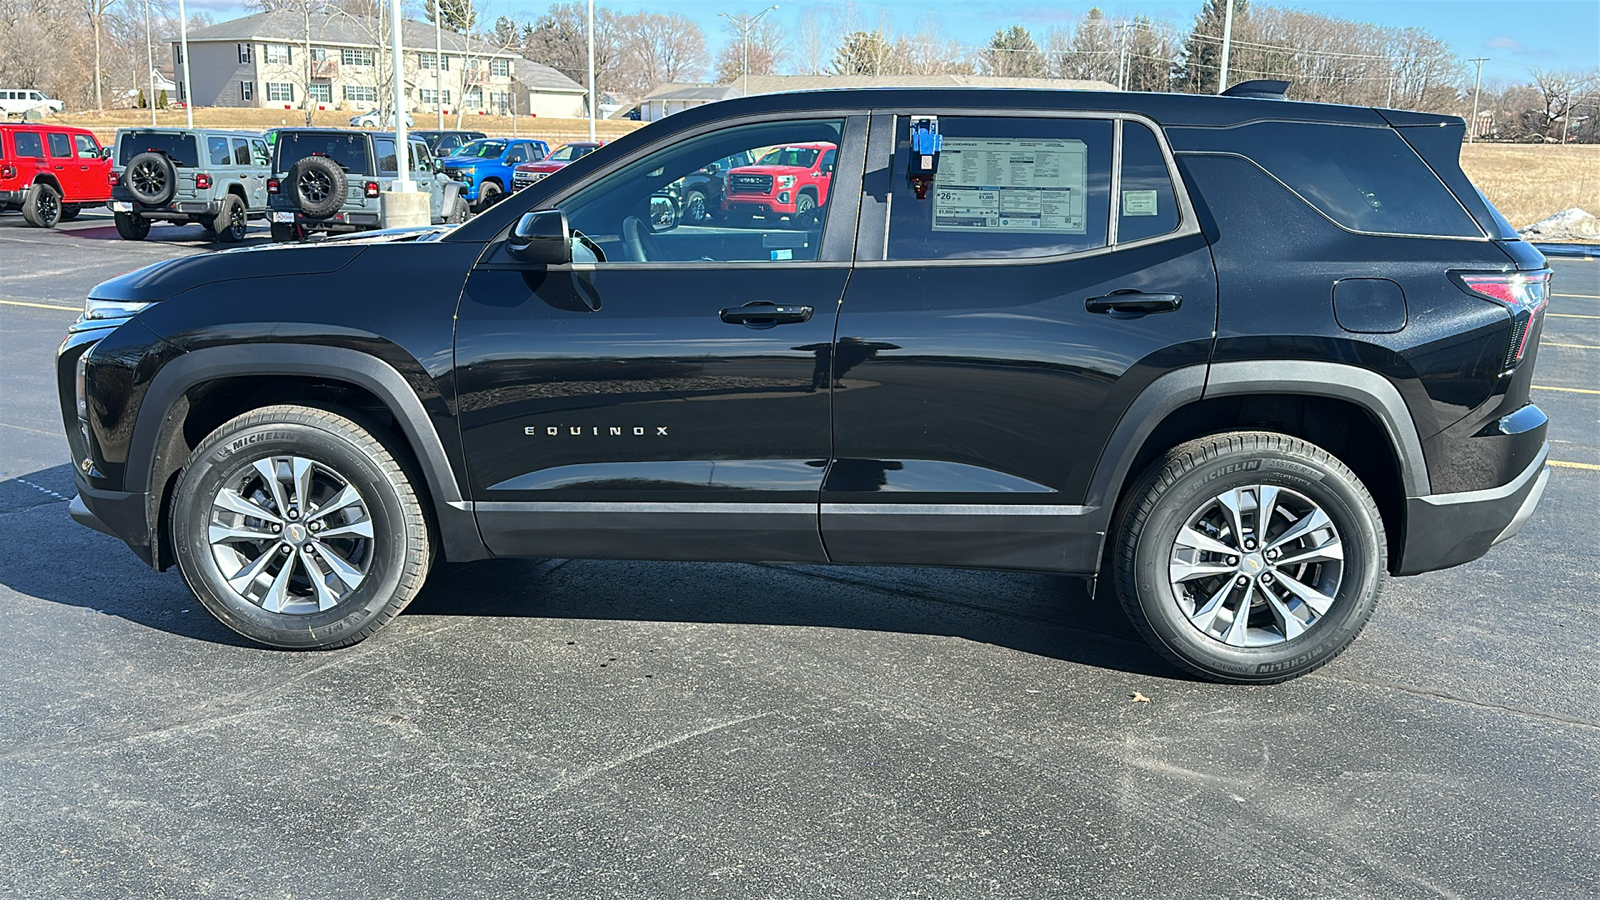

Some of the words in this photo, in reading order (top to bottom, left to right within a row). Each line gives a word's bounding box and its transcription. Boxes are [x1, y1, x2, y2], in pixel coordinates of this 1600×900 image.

[940, 192, 951, 200] 26
[233, 431, 295, 450] MICHELIN
[524, 426, 668, 437] EQUINOX
[1192, 460, 1259, 489] MICHELIN
[1259, 646, 1323, 674] MICHELIN
